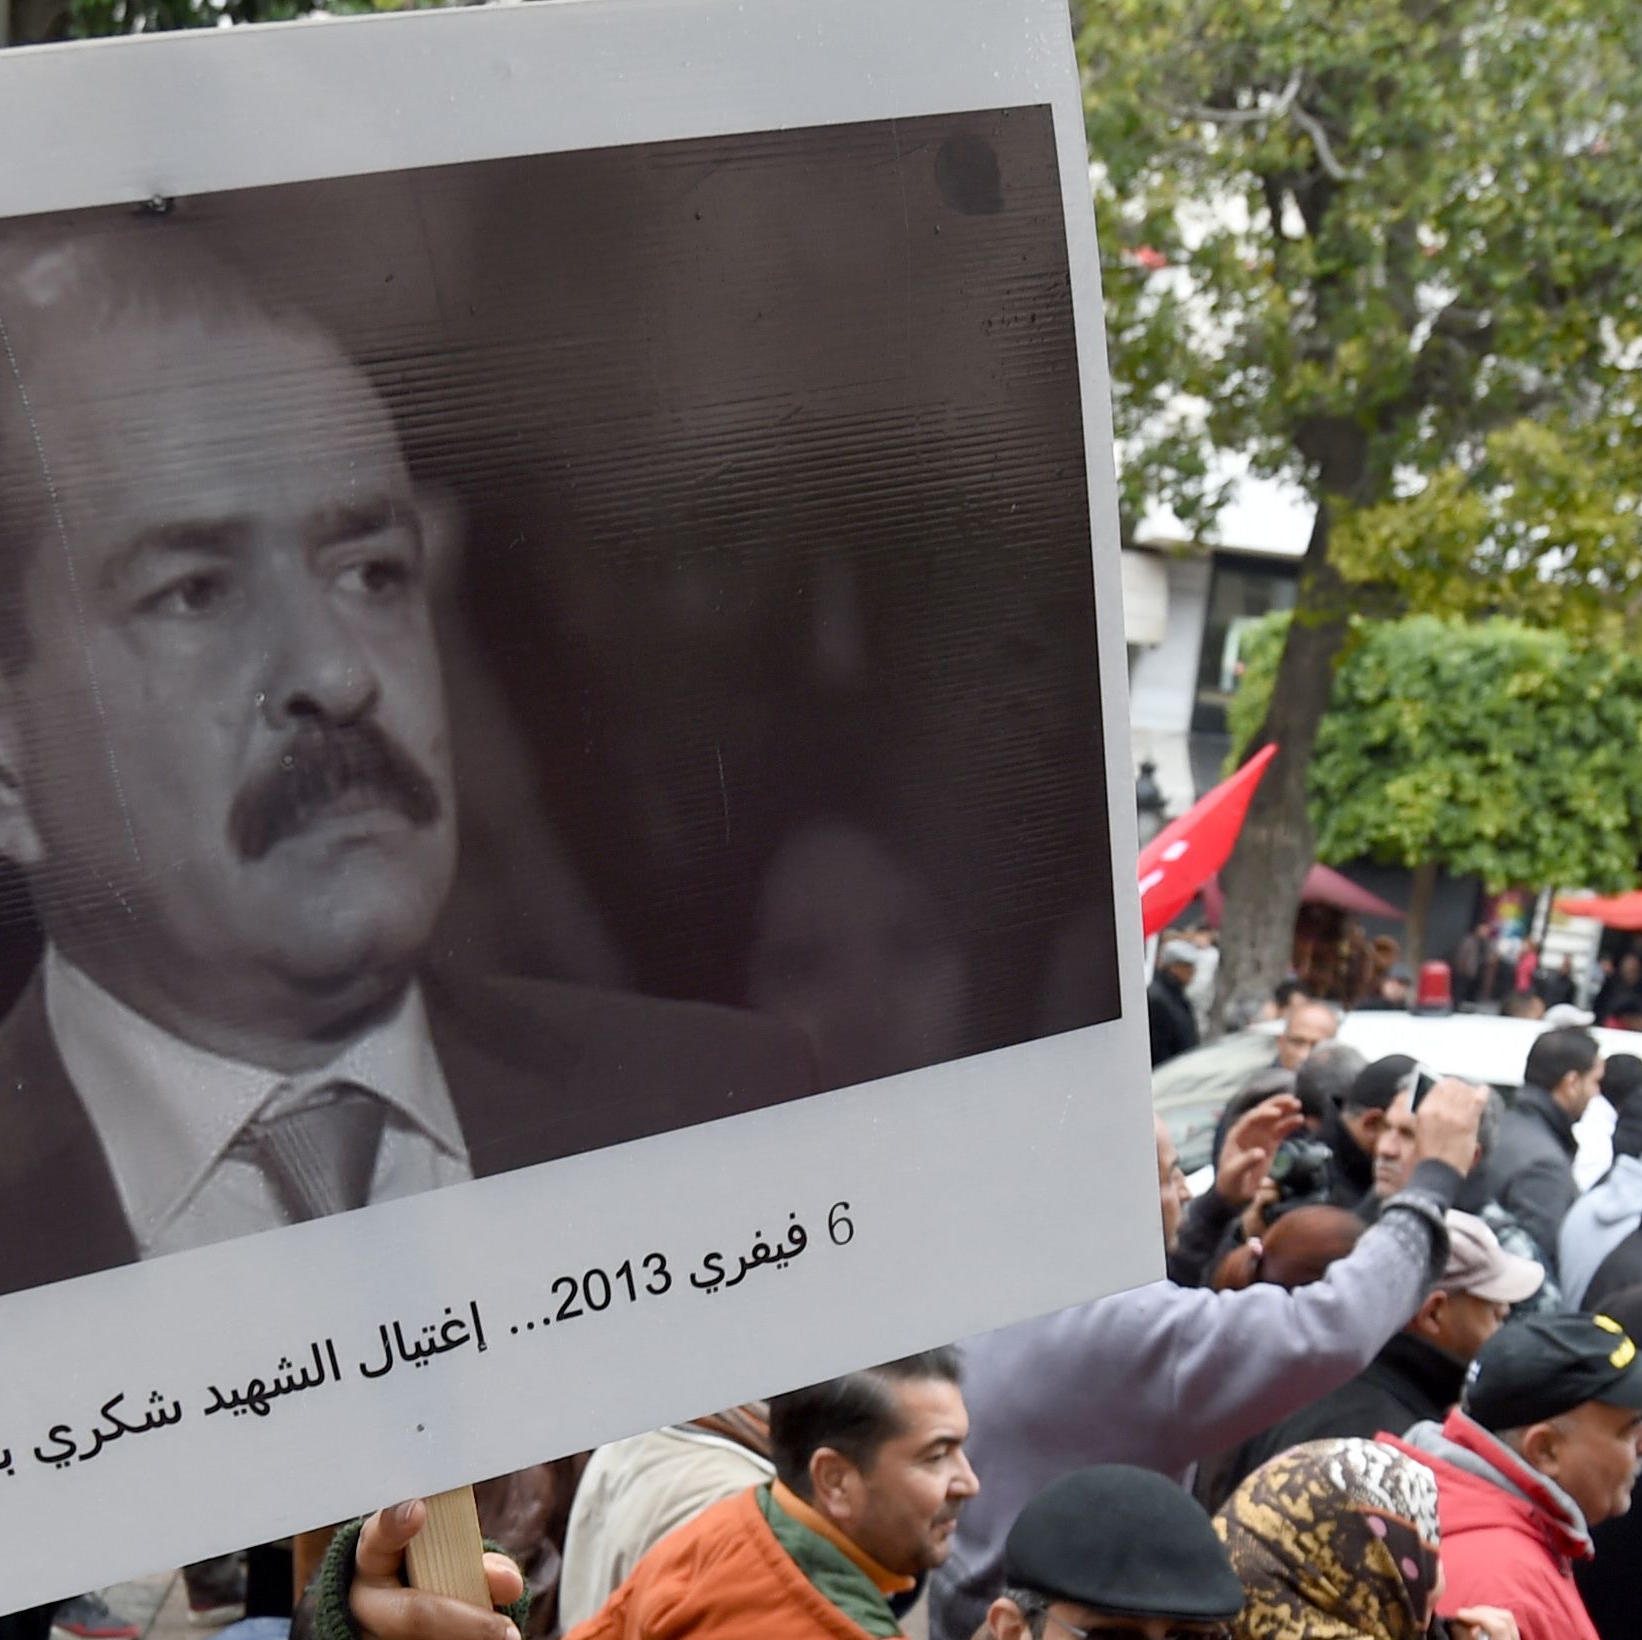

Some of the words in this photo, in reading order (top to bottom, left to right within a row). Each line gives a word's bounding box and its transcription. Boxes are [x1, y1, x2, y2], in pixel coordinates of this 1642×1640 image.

[688, 1211, 809, 1295] فيفري
[827, 1200, 855, 1246] 6
[202, 1338, 343, 1418] الشهيد
[358, 1300, 489, 1379] إغتيال
[32, 1389, 183, 1470] شكري
